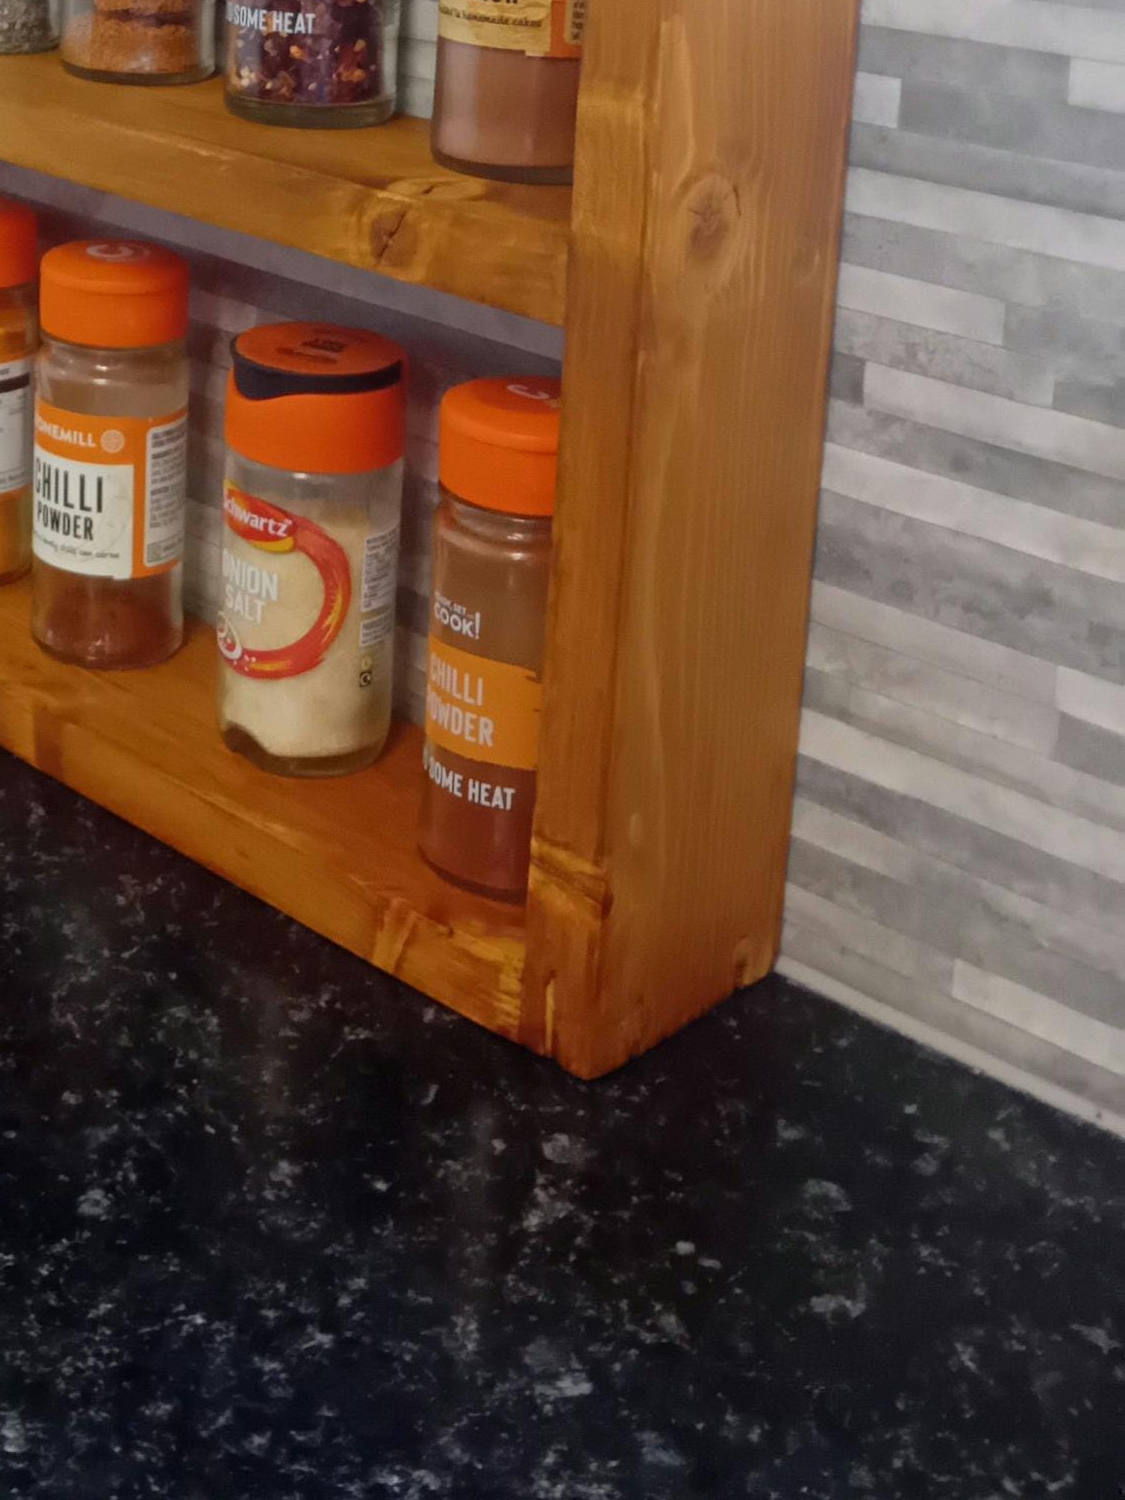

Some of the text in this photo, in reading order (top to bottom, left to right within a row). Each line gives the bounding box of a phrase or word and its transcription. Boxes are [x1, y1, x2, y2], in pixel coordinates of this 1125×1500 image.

[233, 3, 268, 31] SOME
[272, 9, 316, 35] HEAT
[36, 500, 94, 542] POWDER
[225, 583, 266, 624] SALT
[434, 601, 481, 640] COOK!
[468, 778, 516, 811] HEAT
